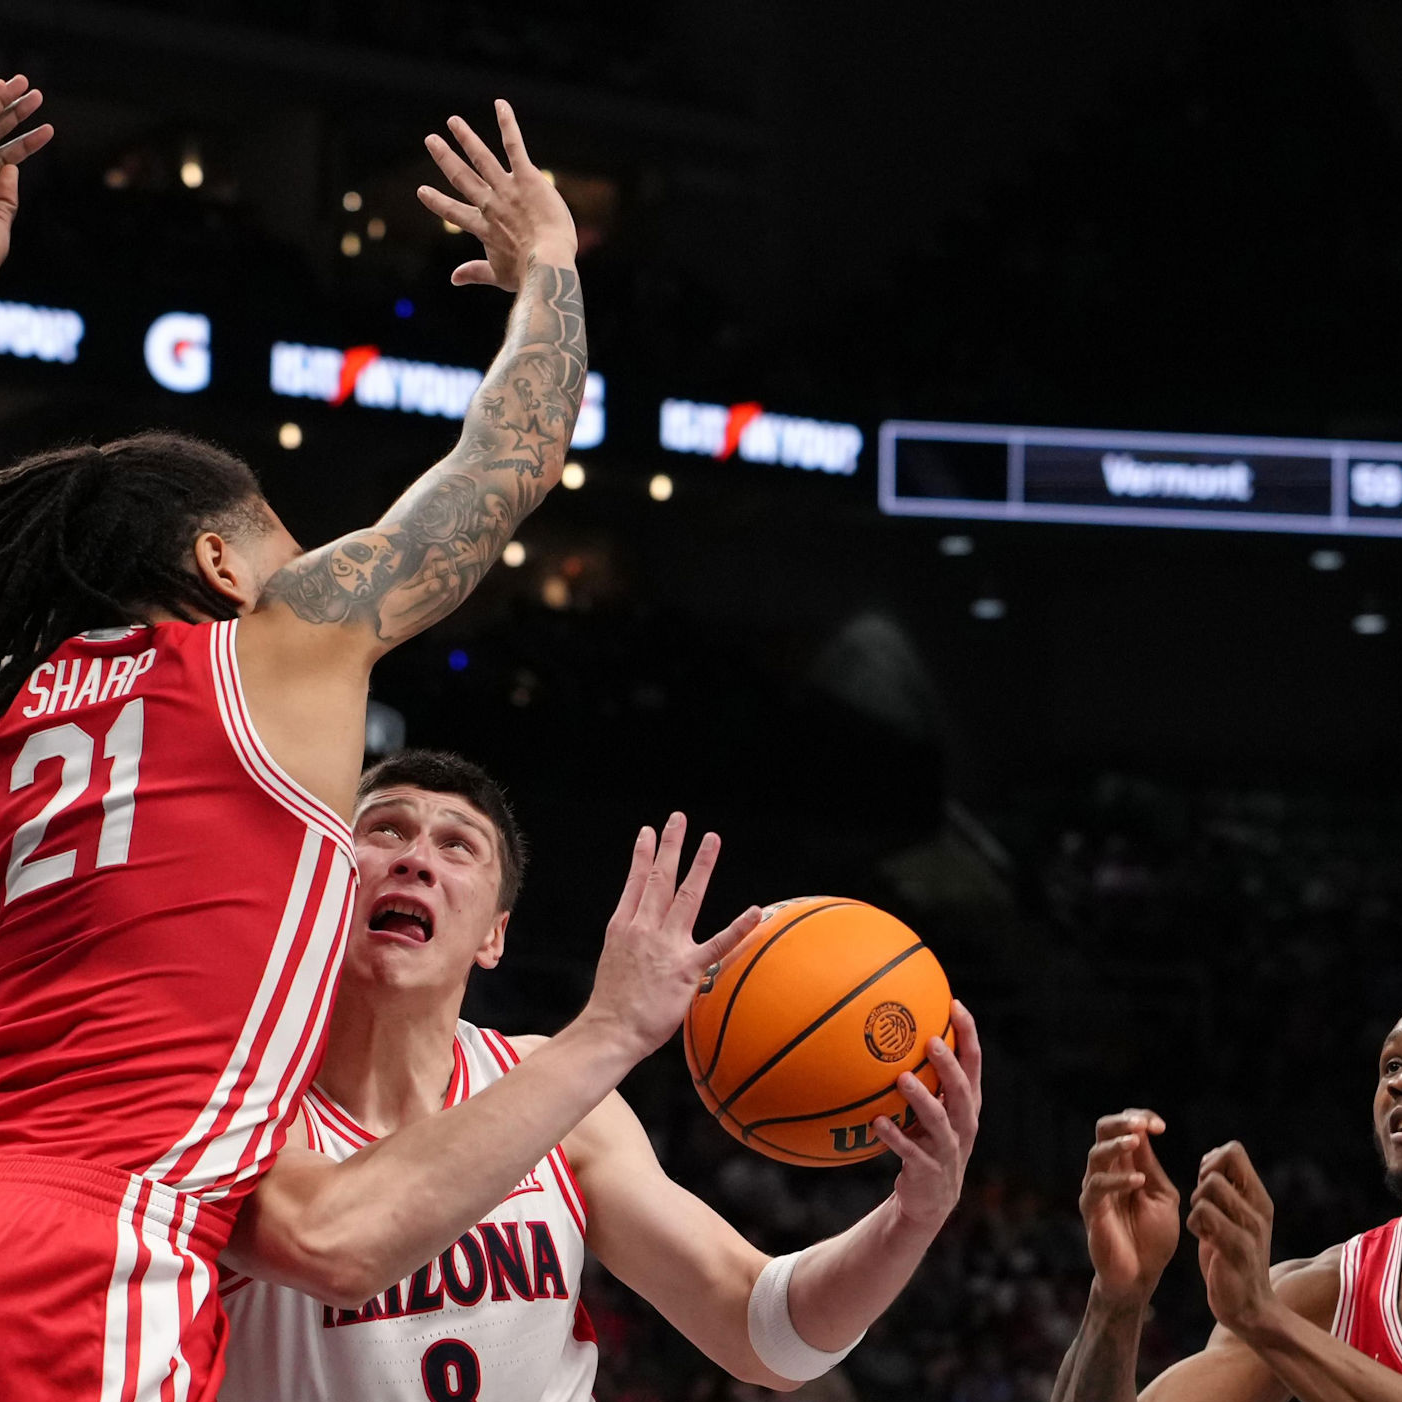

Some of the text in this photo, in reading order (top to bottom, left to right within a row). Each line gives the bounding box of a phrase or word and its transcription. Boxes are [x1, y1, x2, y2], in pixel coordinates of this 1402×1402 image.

[143, 311, 211, 393] G
[23, 648, 157, 719] SHARP
[4, 697, 144, 907] 21
